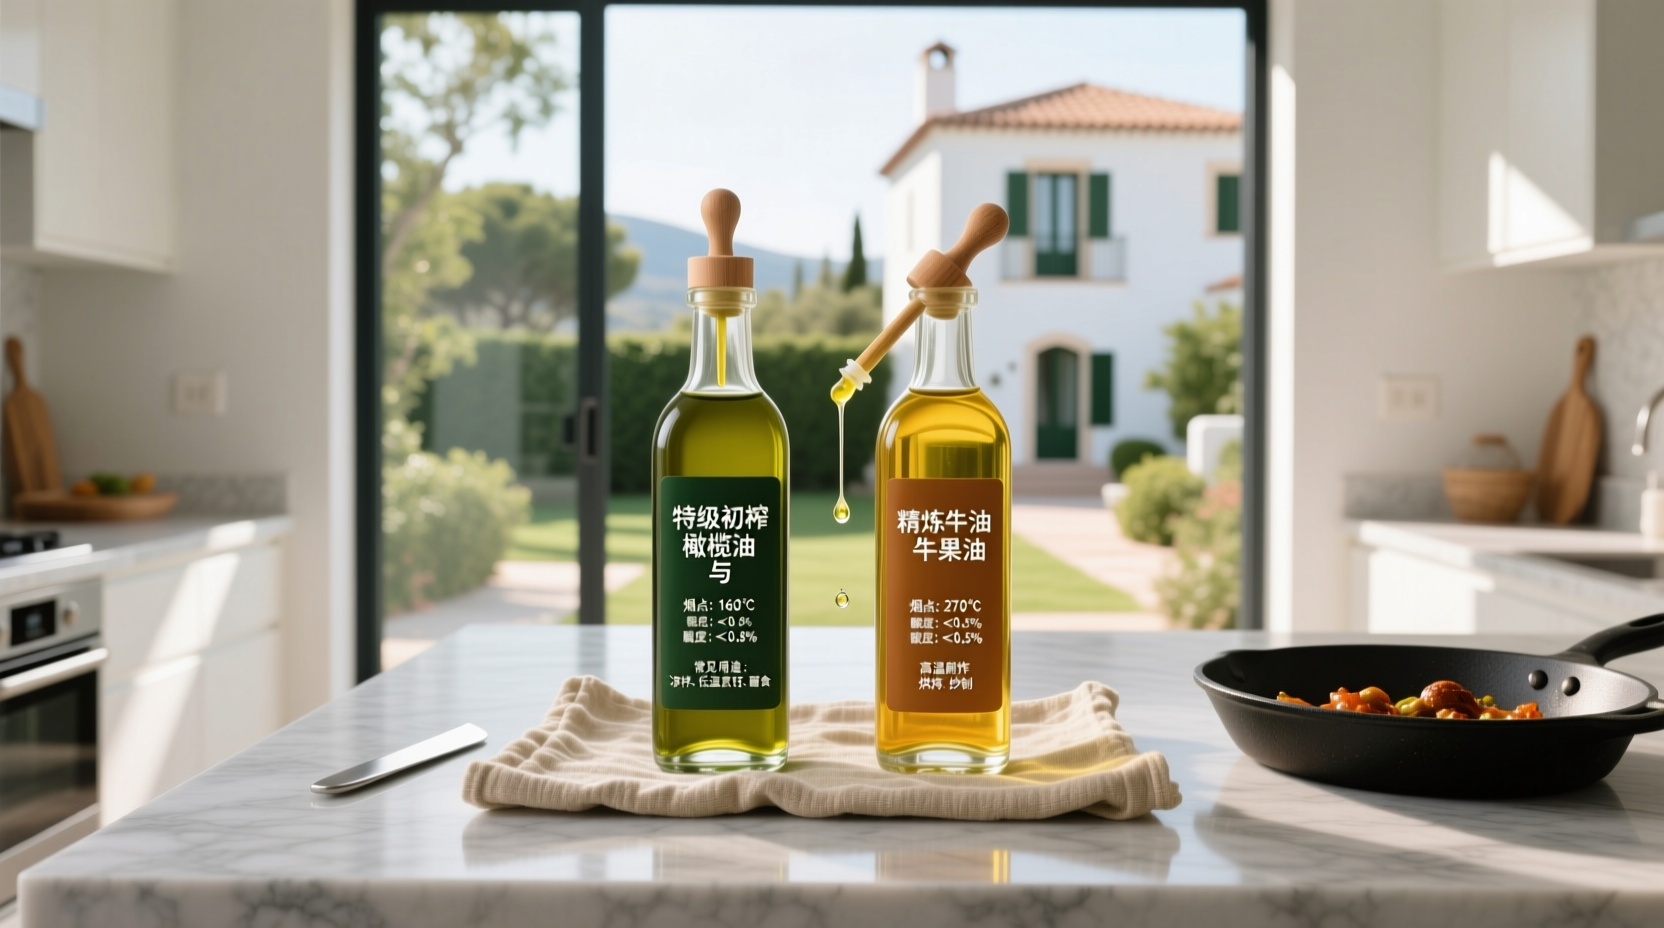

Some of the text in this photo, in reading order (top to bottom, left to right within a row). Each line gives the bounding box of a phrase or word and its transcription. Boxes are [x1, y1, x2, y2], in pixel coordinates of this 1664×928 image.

[672, 504, 769, 531] 特级初榨
[897, 509, 991, 534] 精炼牛油
[682, 531, 755, 559] 橄榄油
[912, 536, 986, 562] 牛果油
[708, 559, 731, 584] 与
